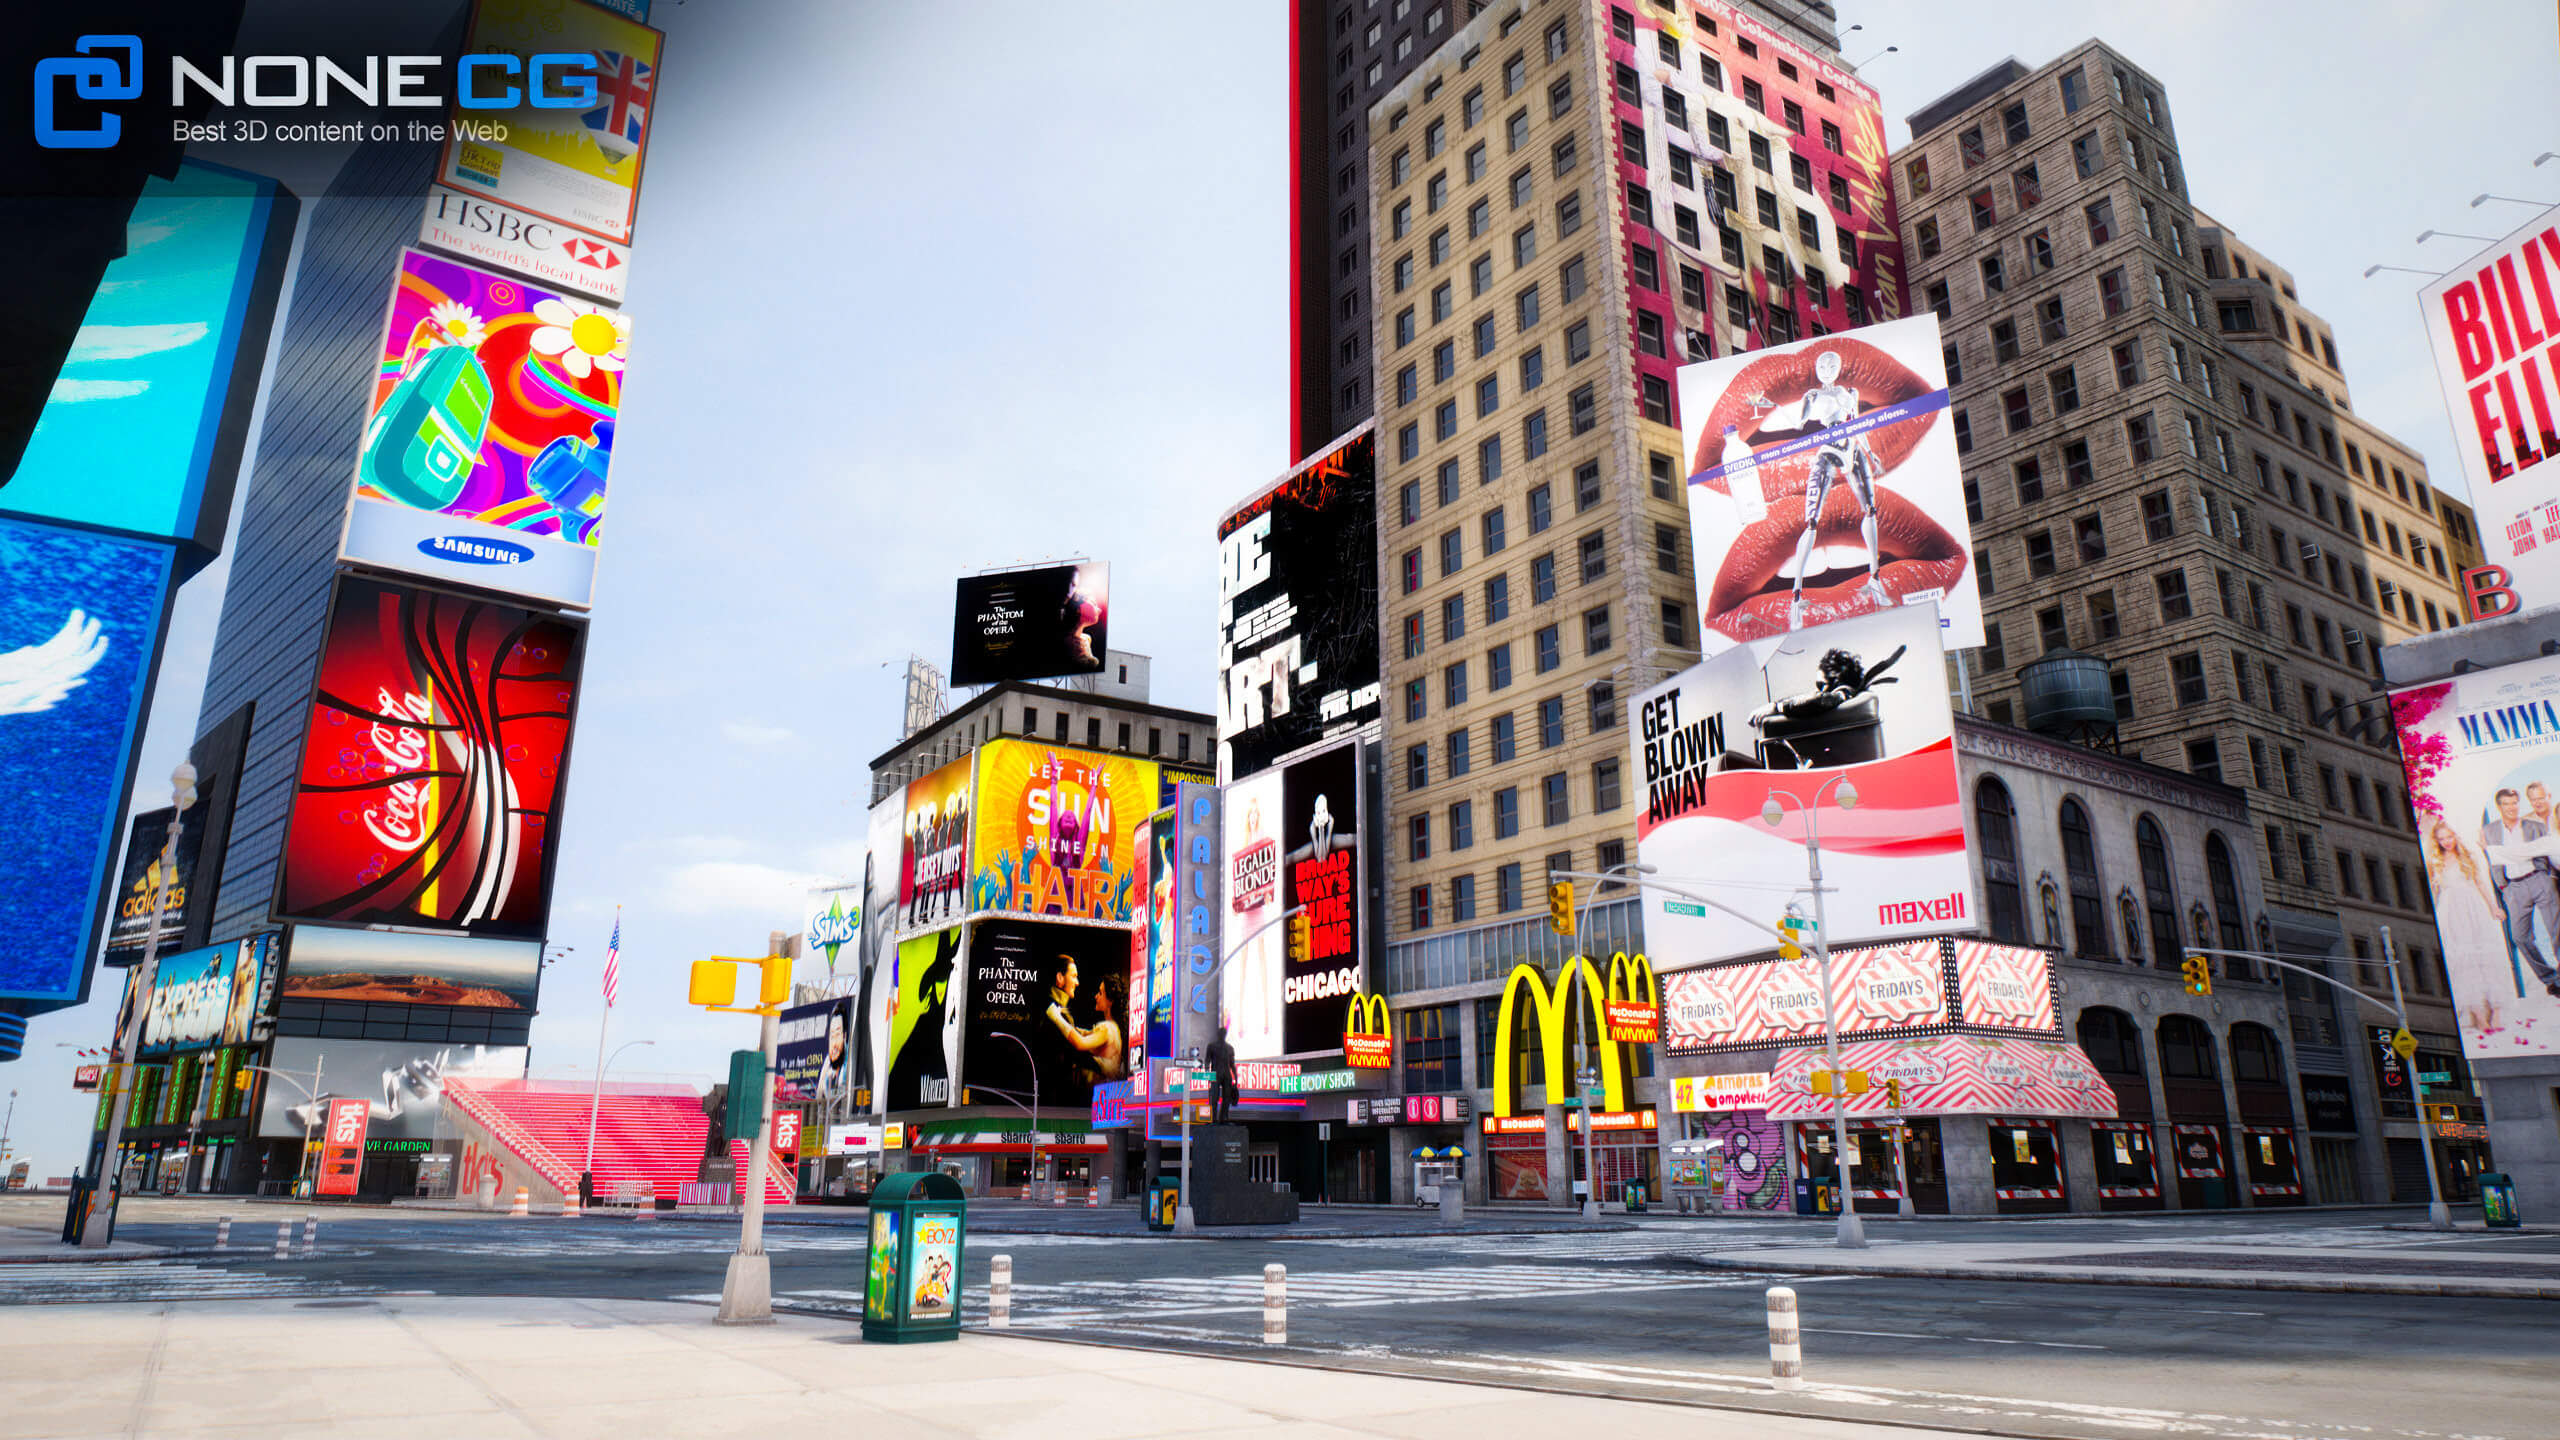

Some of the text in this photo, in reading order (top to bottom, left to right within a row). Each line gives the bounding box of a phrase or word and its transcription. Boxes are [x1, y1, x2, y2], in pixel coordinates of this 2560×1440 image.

[1735, 12, 1820, 72] Colombian
[1822, 64, 1872, 101] Coffee
[437, 193, 552, 250] HSBC
[432, 228, 618, 296] The world's local bank
[1723, 455, 1756, 474] SVEDKA
[1760, 449, 1780, 462] man
[1831, 428, 1845, 437] on
[1845, 418, 1876, 436] gossip
[1877, 408, 1909, 423] alone.
[433, 537, 520, 565] SAMSUNG
[977, 609, 1024, 622] PHANTOM
[983, 626, 1015, 635] OPERA
[1641, 687, 1682, 742] GET
[1644, 711, 1727, 785] BLOWN
[363, 686, 433, 852] Coca-Cola
[1029, 761, 1111, 787] LET THE
[1027, 788, 1110, 833] SUN
[1648, 763, 1709, 825] AWAY
[1026, 835, 1109, 860] SHINE IN
[1234, 844, 1276, 879] LEGALLY
[1011, 862, 1117, 920] HAIR
[1235, 864, 1276, 898] BLONDE
[1296, 870, 1350, 904] WAY'S
[1190, 797, 1212, 1014] PALACE
[1306, 894, 1350, 926] URE
[1879, 892, 1966, 926] maxell
[811, 911, 856, 950] SIMS
[979, 967, 1038, 982] PHANTOM
[1000, 957, 1015, 967] The
[986, 991, 1026, 1005] OPERA
[1869, 979, 1924, 1000] FRiDAYS
[1280, 1071, 1356, 1093] THE BODY SHOP
[1676, 1084, 1692, 1104] 47
[335, 1103, 360, 1143] tkts
[777, 1113, 799, 1148] tkts
[1001, 1129, 1033, 1144] sbarro
[1055, 1131, 1086, 1144] sbarro
[383, 1141, 431, 1152] GARDEN
